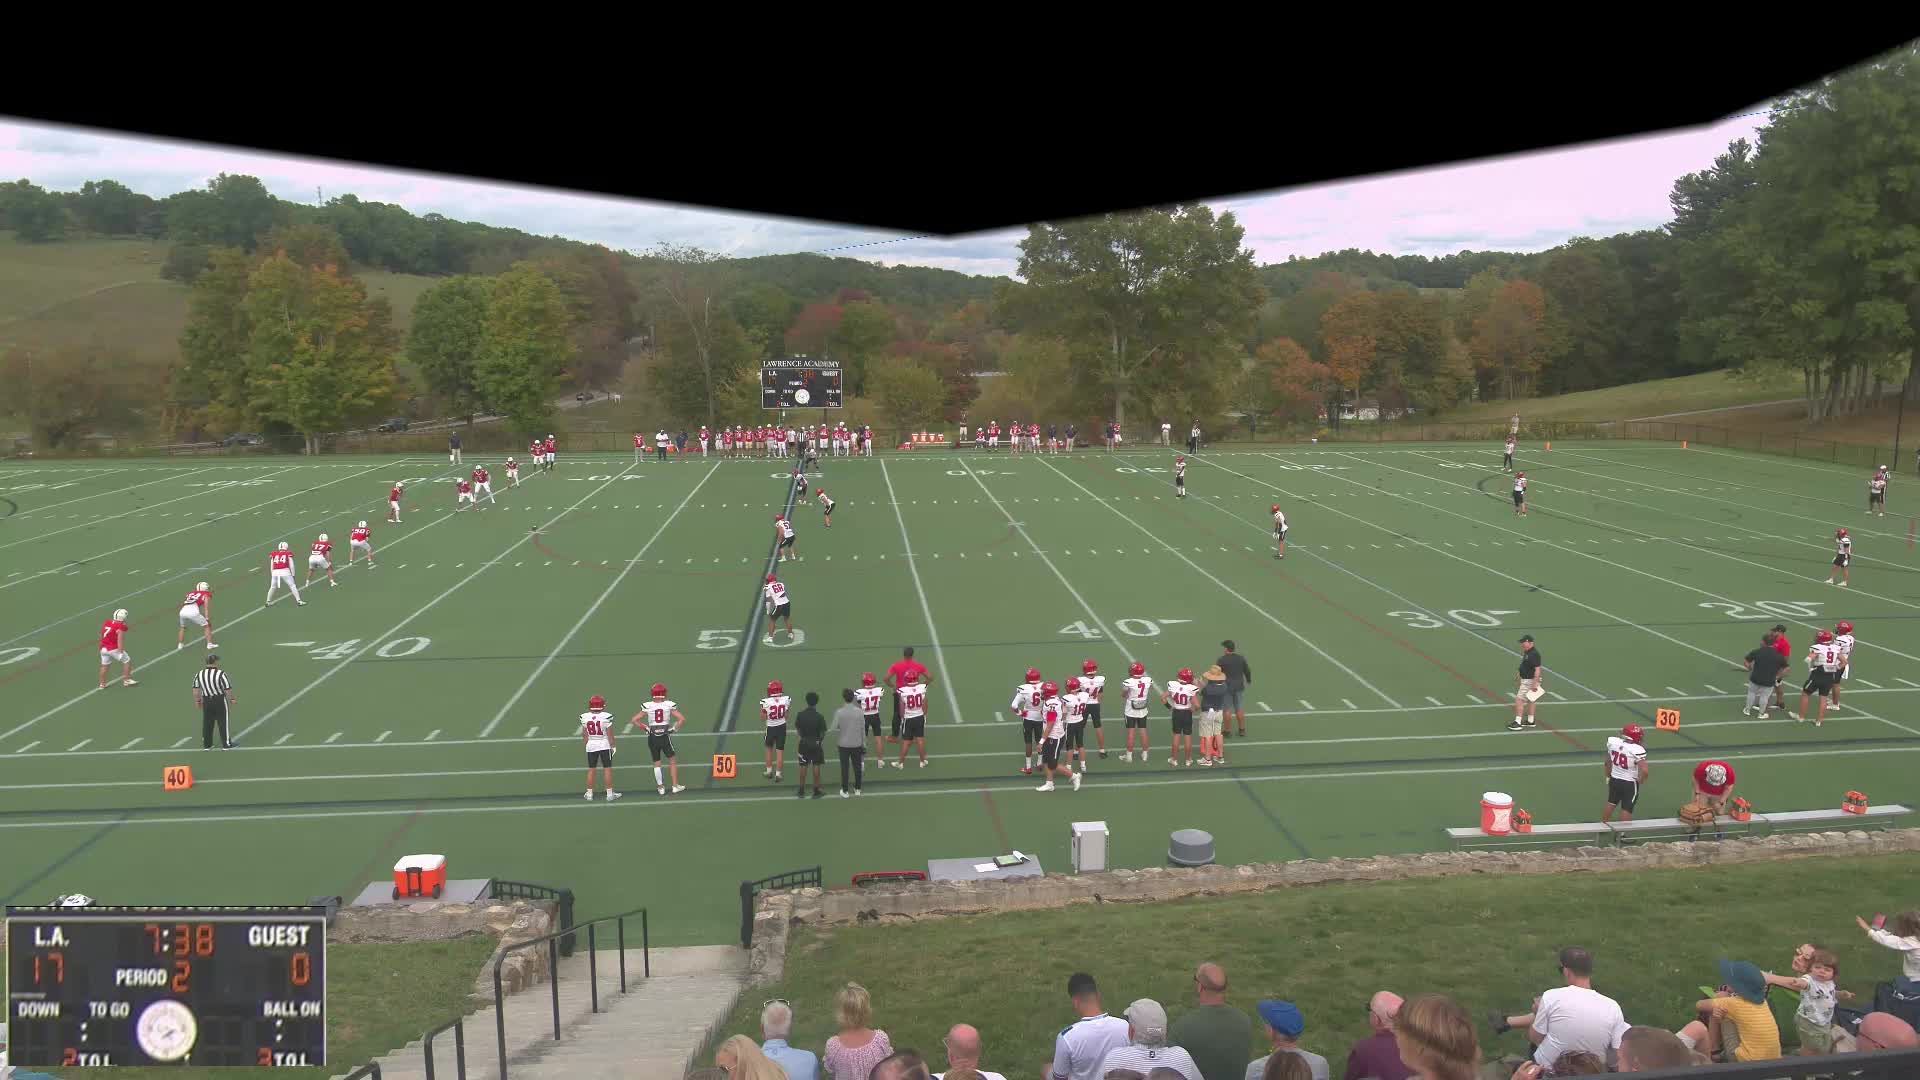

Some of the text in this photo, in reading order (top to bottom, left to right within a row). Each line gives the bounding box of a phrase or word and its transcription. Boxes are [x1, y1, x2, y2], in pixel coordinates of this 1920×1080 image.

[273, 555, 287, 564] 44
[772, 583, 785, 594] 68
[102, 626, 112, 638] 7
[1058, 618, 1161, 639] 40
[696, 628, 805, 649] 50
[306, 636, 431, 659] 40
[1826, 651, 1834, 664] 9
[1137, 683, 1146, 699] 7
[864, 697, 879, 711] 17
[1031, 692, 1041, 707] 6
[1172, 694, 1188, 706] 40
[654, 708, 664, 724] 8
[768, 705, 786, 721] 20
[1660, 711, 1677, 726] 30
[586, 720, 604, 736] 81
[716, 756, 733, 774] 50
[1611, 750, 1629, 770] 78
[167, 768, 186, 786] 40
